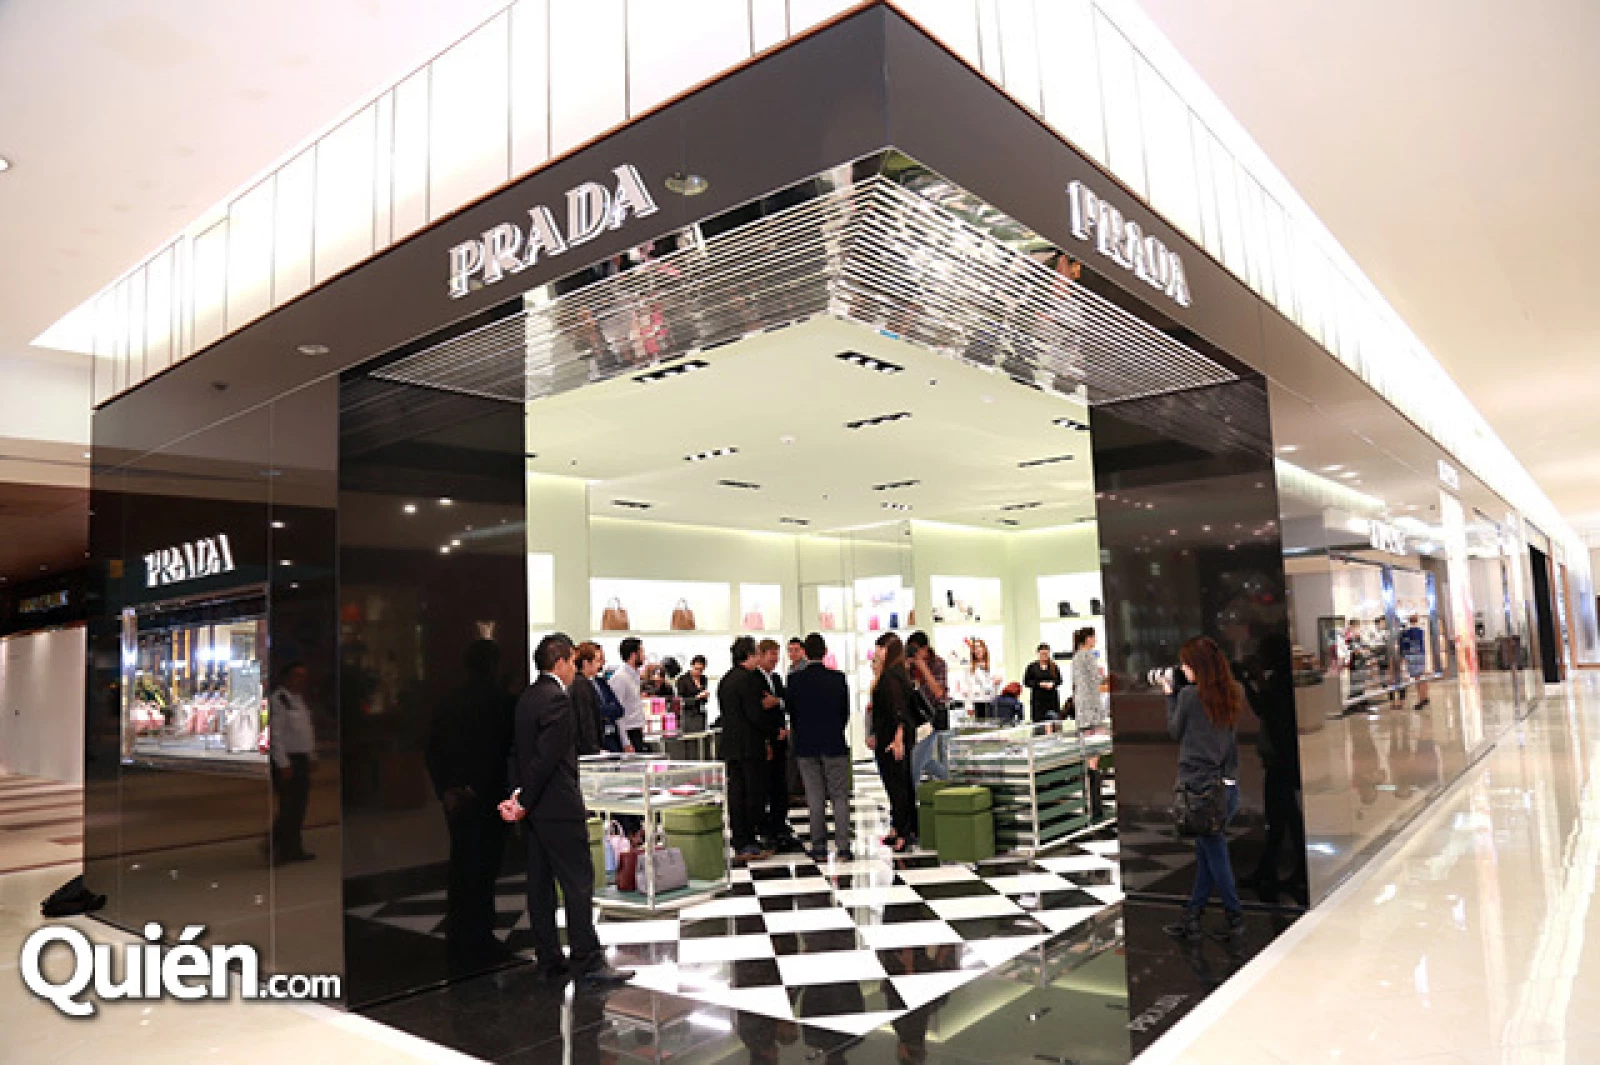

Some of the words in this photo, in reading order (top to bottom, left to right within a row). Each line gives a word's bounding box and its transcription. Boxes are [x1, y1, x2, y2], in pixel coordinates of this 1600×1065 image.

[447, 164, 659, 298] PRADA
[1065, 180, 1192, 308] PRADA
[143, 533, 235, 588] PRADA
